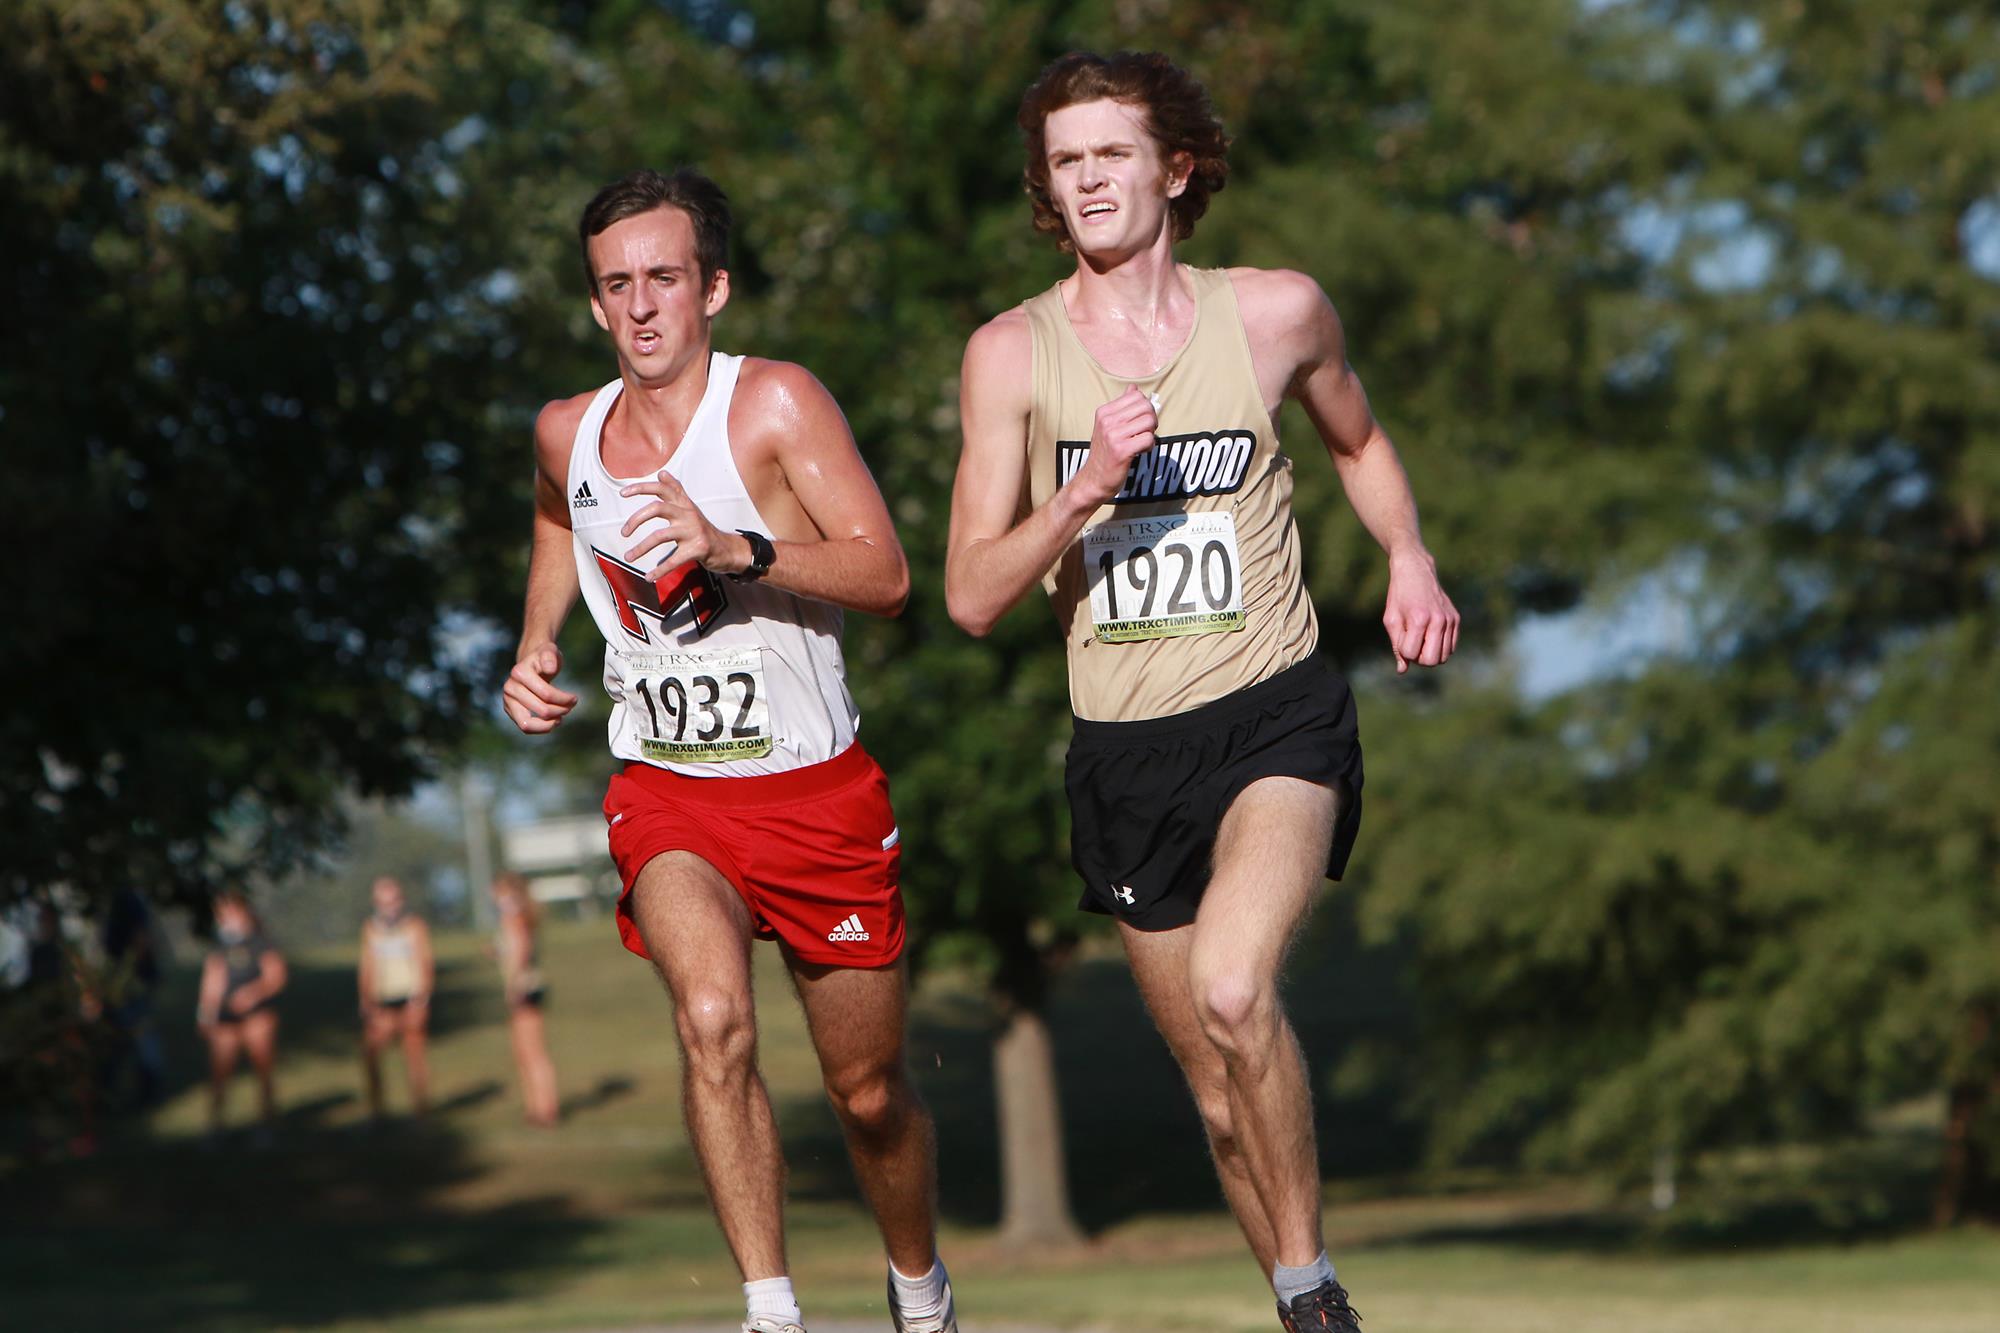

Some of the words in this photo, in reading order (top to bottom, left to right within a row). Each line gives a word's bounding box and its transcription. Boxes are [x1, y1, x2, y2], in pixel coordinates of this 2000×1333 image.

[1122, 519, 1188, 536] TRXC
[1098, 540, 1233, 620] 1920
[1098, 612, 1238, 633] WWW.TRXCTIMING.COM
[656, 653, 713, 665] TRXC
[635, 672, 760, 741] 1932
[644, 738, 765, 754] WWW.TRXCTIMING.COM
[828, 930, 870, 942] adidas
